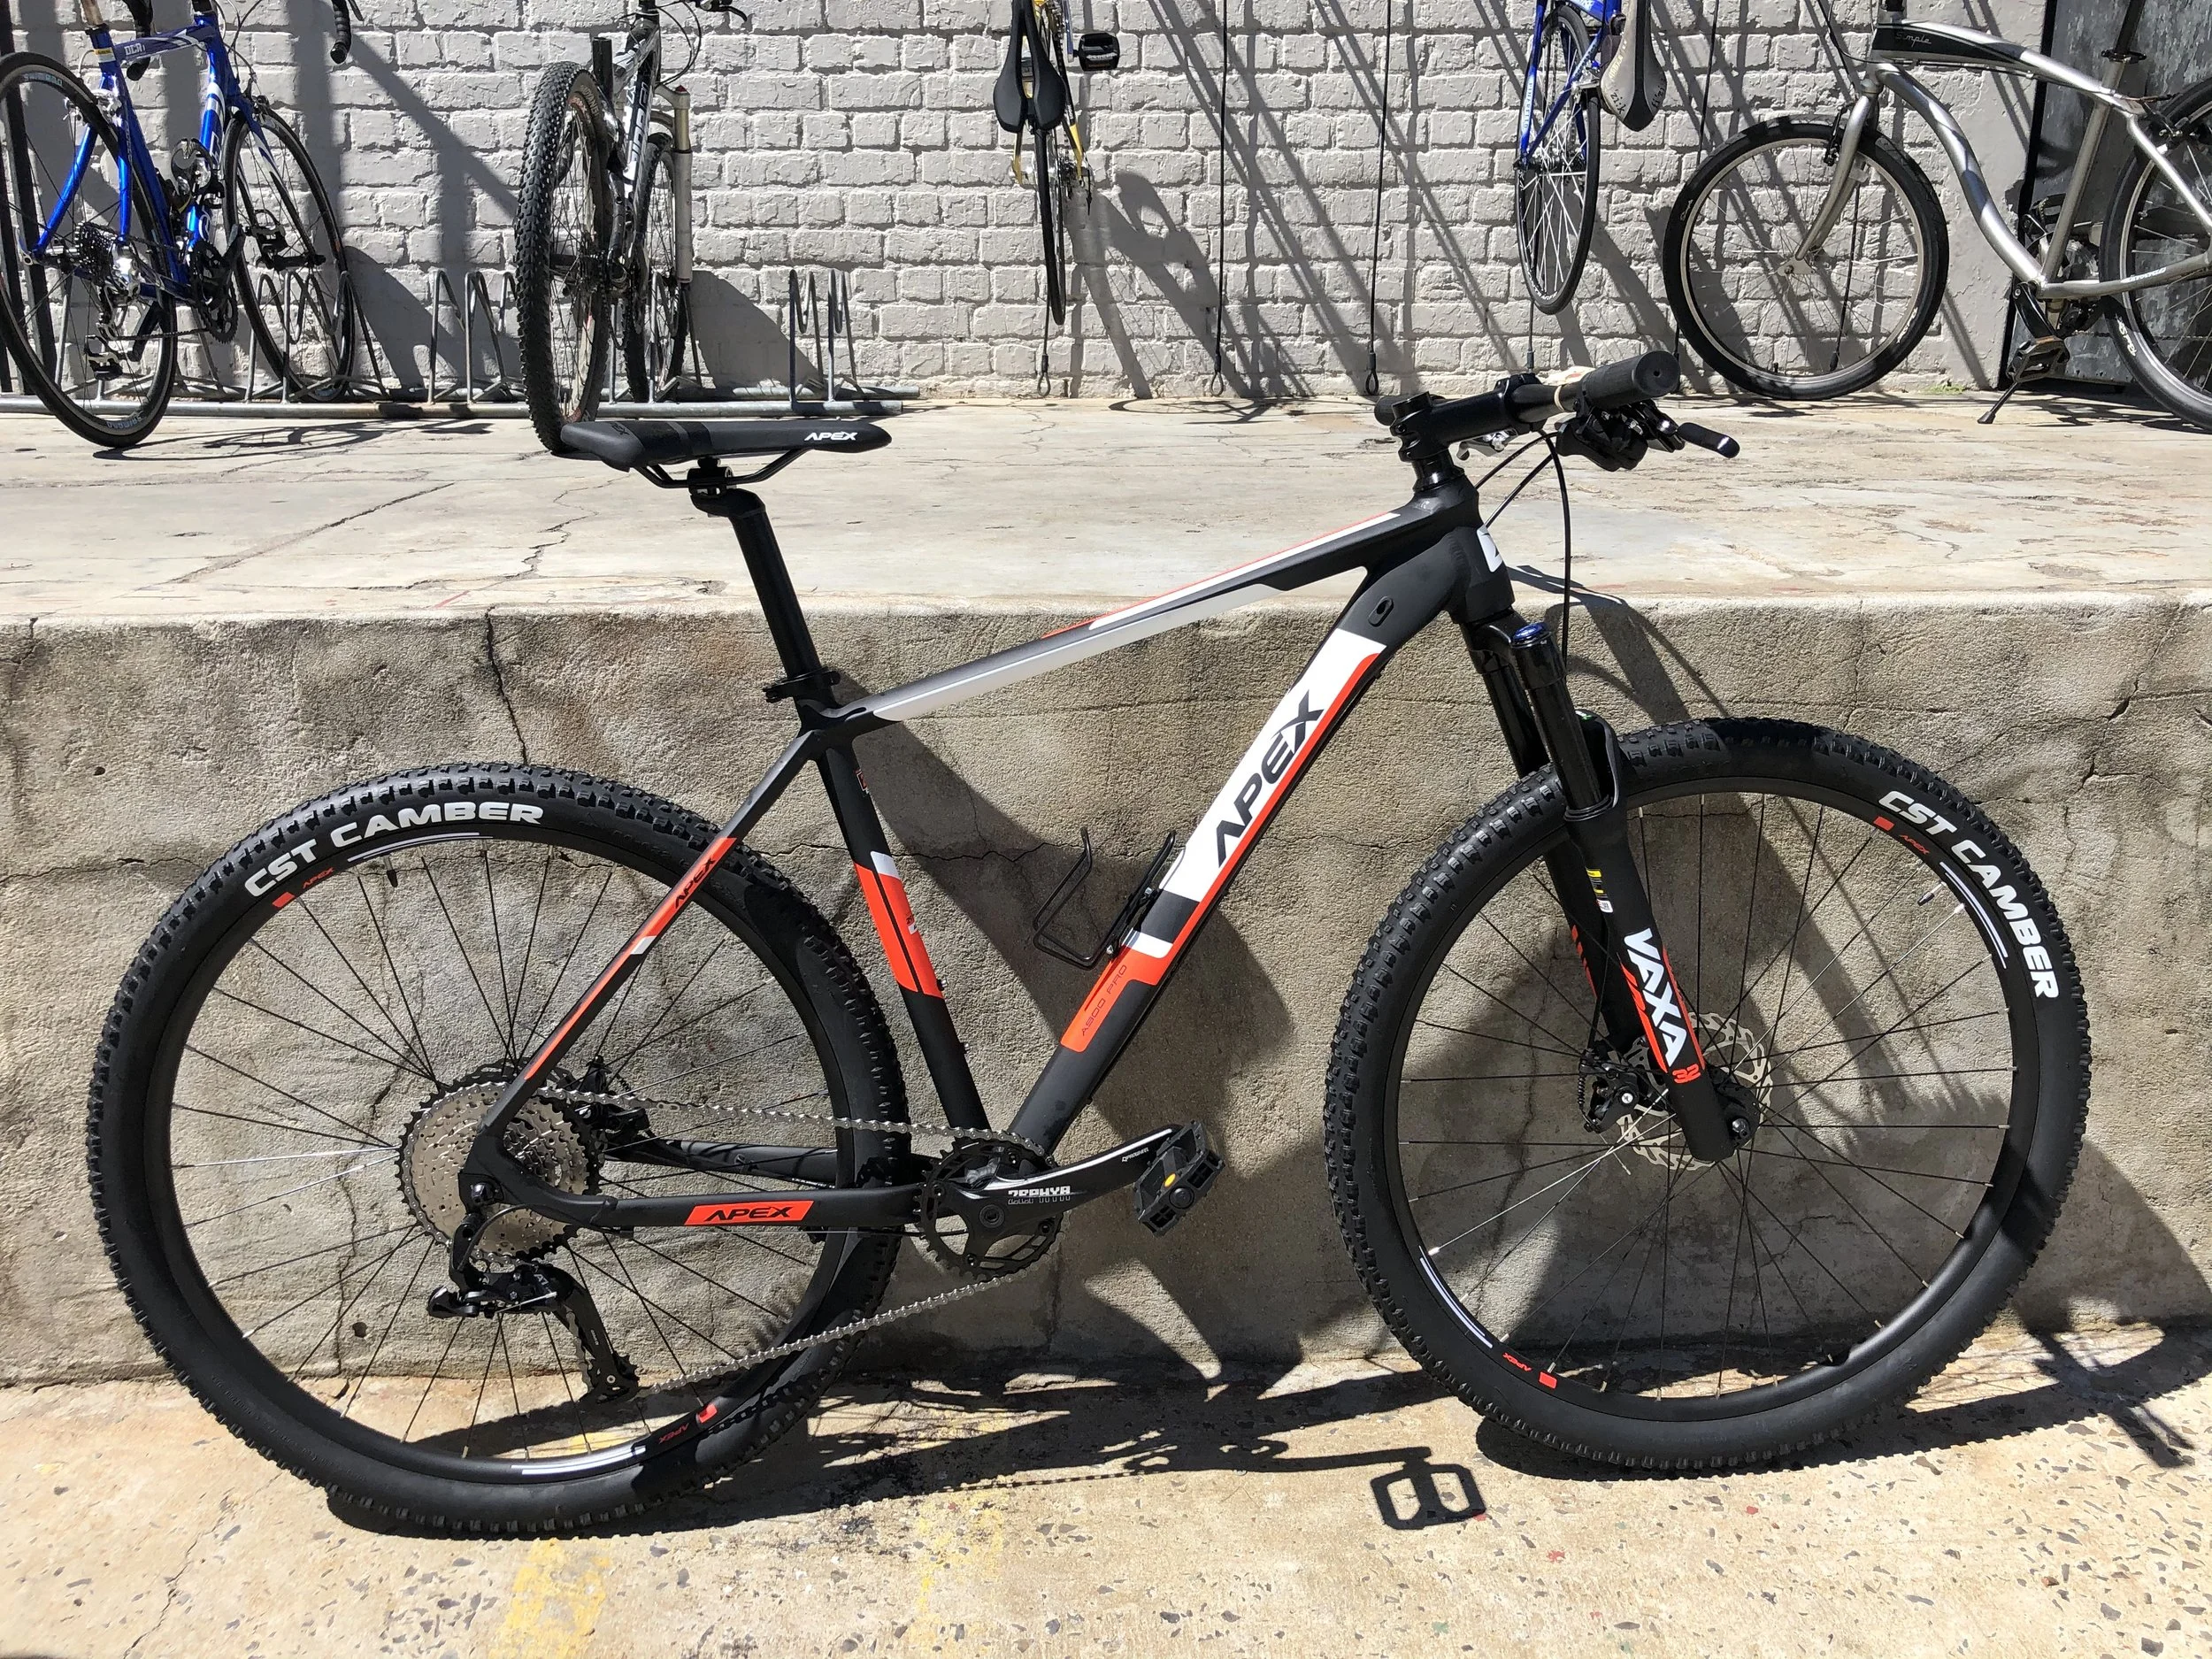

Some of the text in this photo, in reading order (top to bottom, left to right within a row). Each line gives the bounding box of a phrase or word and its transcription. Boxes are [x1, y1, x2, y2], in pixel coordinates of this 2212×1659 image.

[804, 431, 857, 441] APEX
[1215, 689, 1325, 868] APEX
[245, 802, 544, 897] CST CAMBER
[1900, 834, 1931, 855] APEX
[302, 866, 334, 888] APEX
[674, 857, 717, 910] APEX
[1878, 790, 2060, 999] CST CAMBER
[1106, 964, 1127, 995] PRO
[1624, 927, 1688, 1067] VAXA
[703, 1206, 794, 1222] APEX
[1502, 1352, 1532, 1371] APEX
[658, 1422, 689, 1444] APEX
